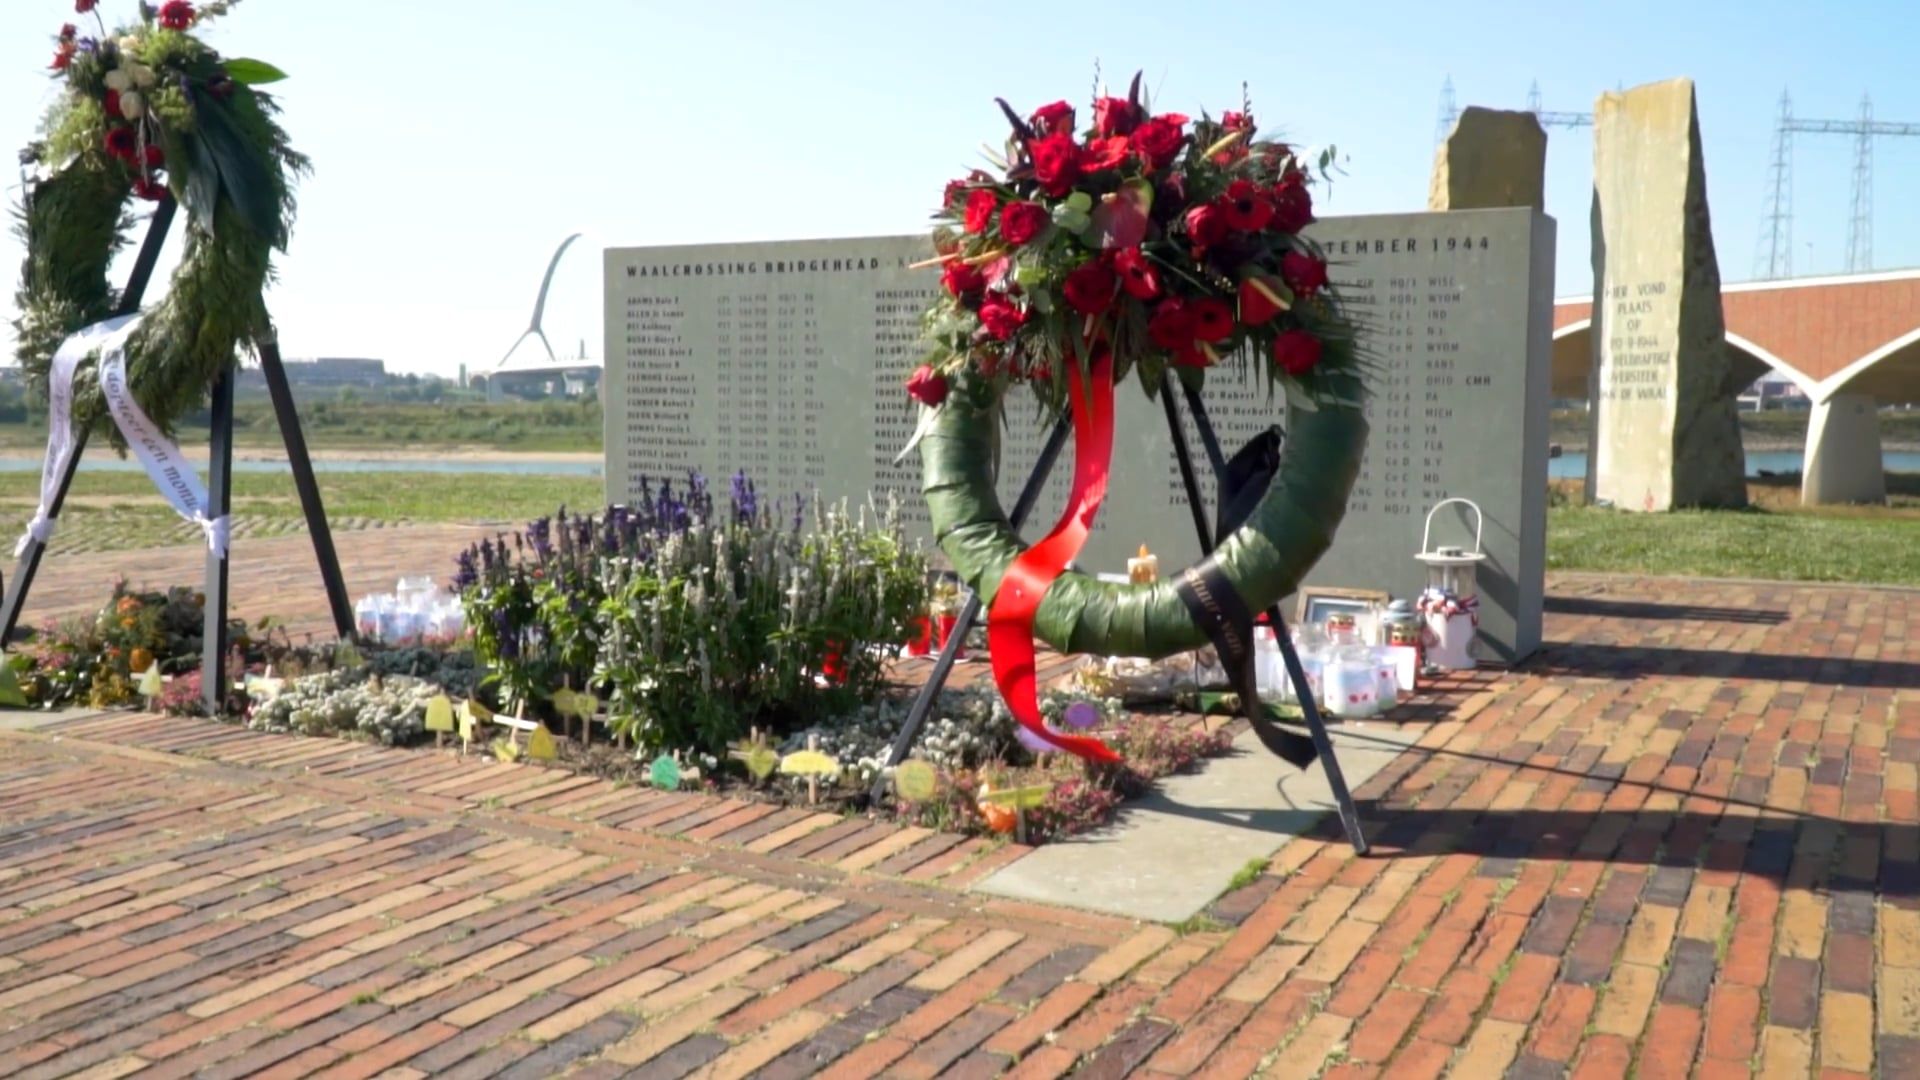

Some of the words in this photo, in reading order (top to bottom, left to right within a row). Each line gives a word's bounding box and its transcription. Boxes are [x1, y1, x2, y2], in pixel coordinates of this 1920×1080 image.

[627, 264, 756, 277] WAALCROSSING
[765, 258, 879, 273] BRIDGEHEAD
[1325, 238, 1416, 254] TEMBER
[1432, 236, 1489, 252] 1944
[1637, 282, 1666, 296] VOND
[1617, 300, 1653, 316] PLAATS
[1426, 408, 1452, 418] MICH
